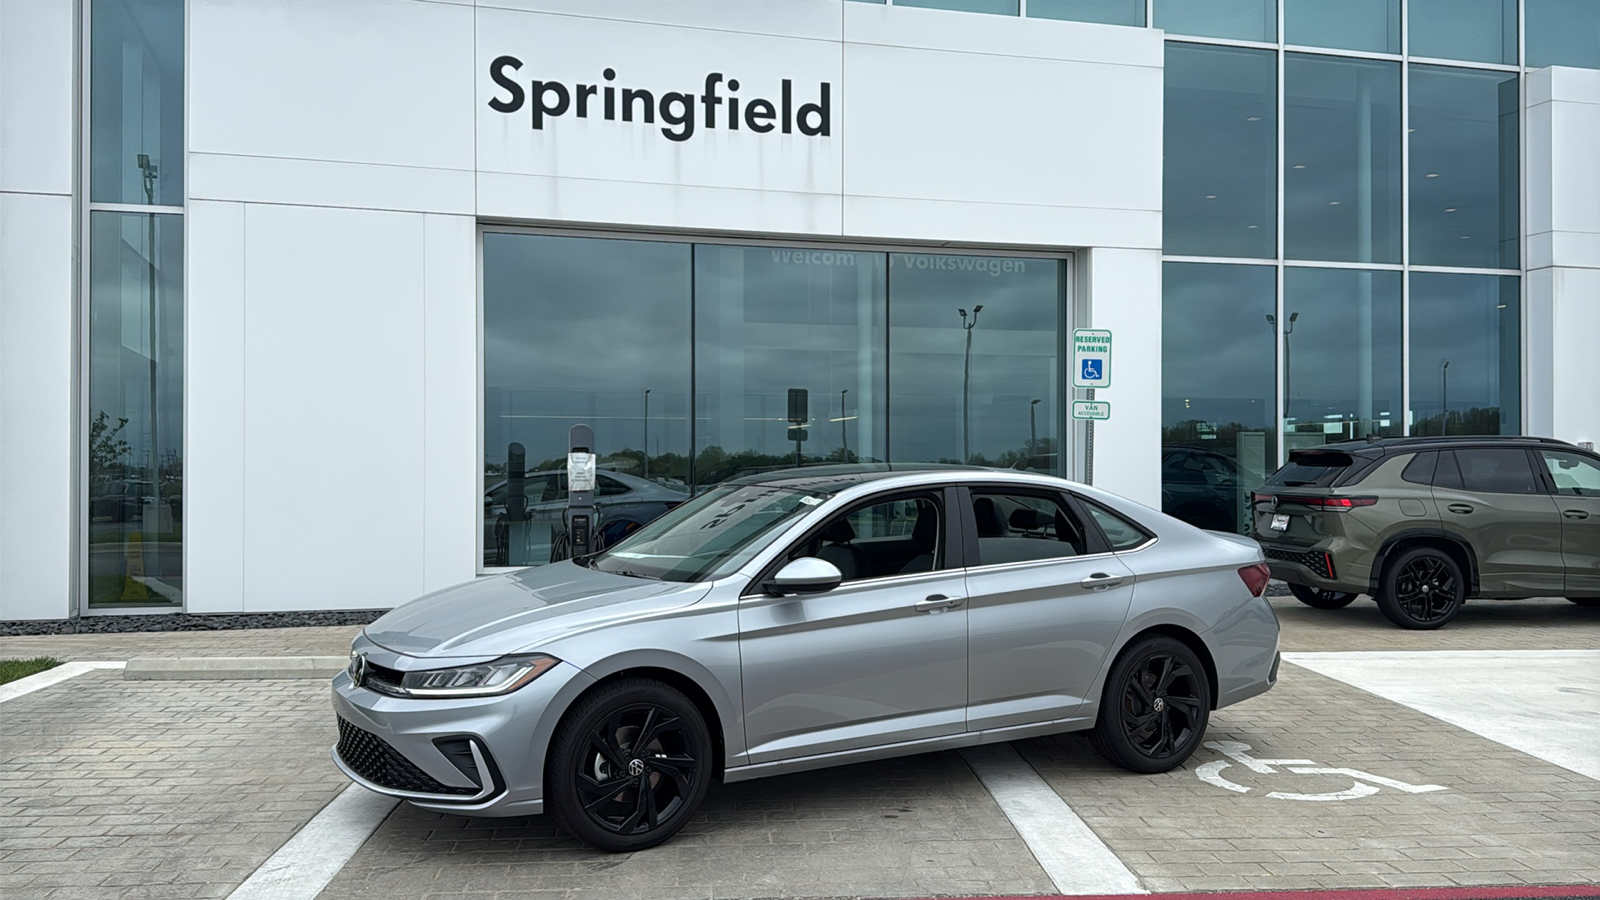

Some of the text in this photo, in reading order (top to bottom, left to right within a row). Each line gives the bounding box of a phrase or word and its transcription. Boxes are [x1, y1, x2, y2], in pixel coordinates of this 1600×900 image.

[488, 55, 831, 142] Springfield
[904, 256, 1025, 277] Volkswagen
[1077, 345, 1107, 353] PARKING
